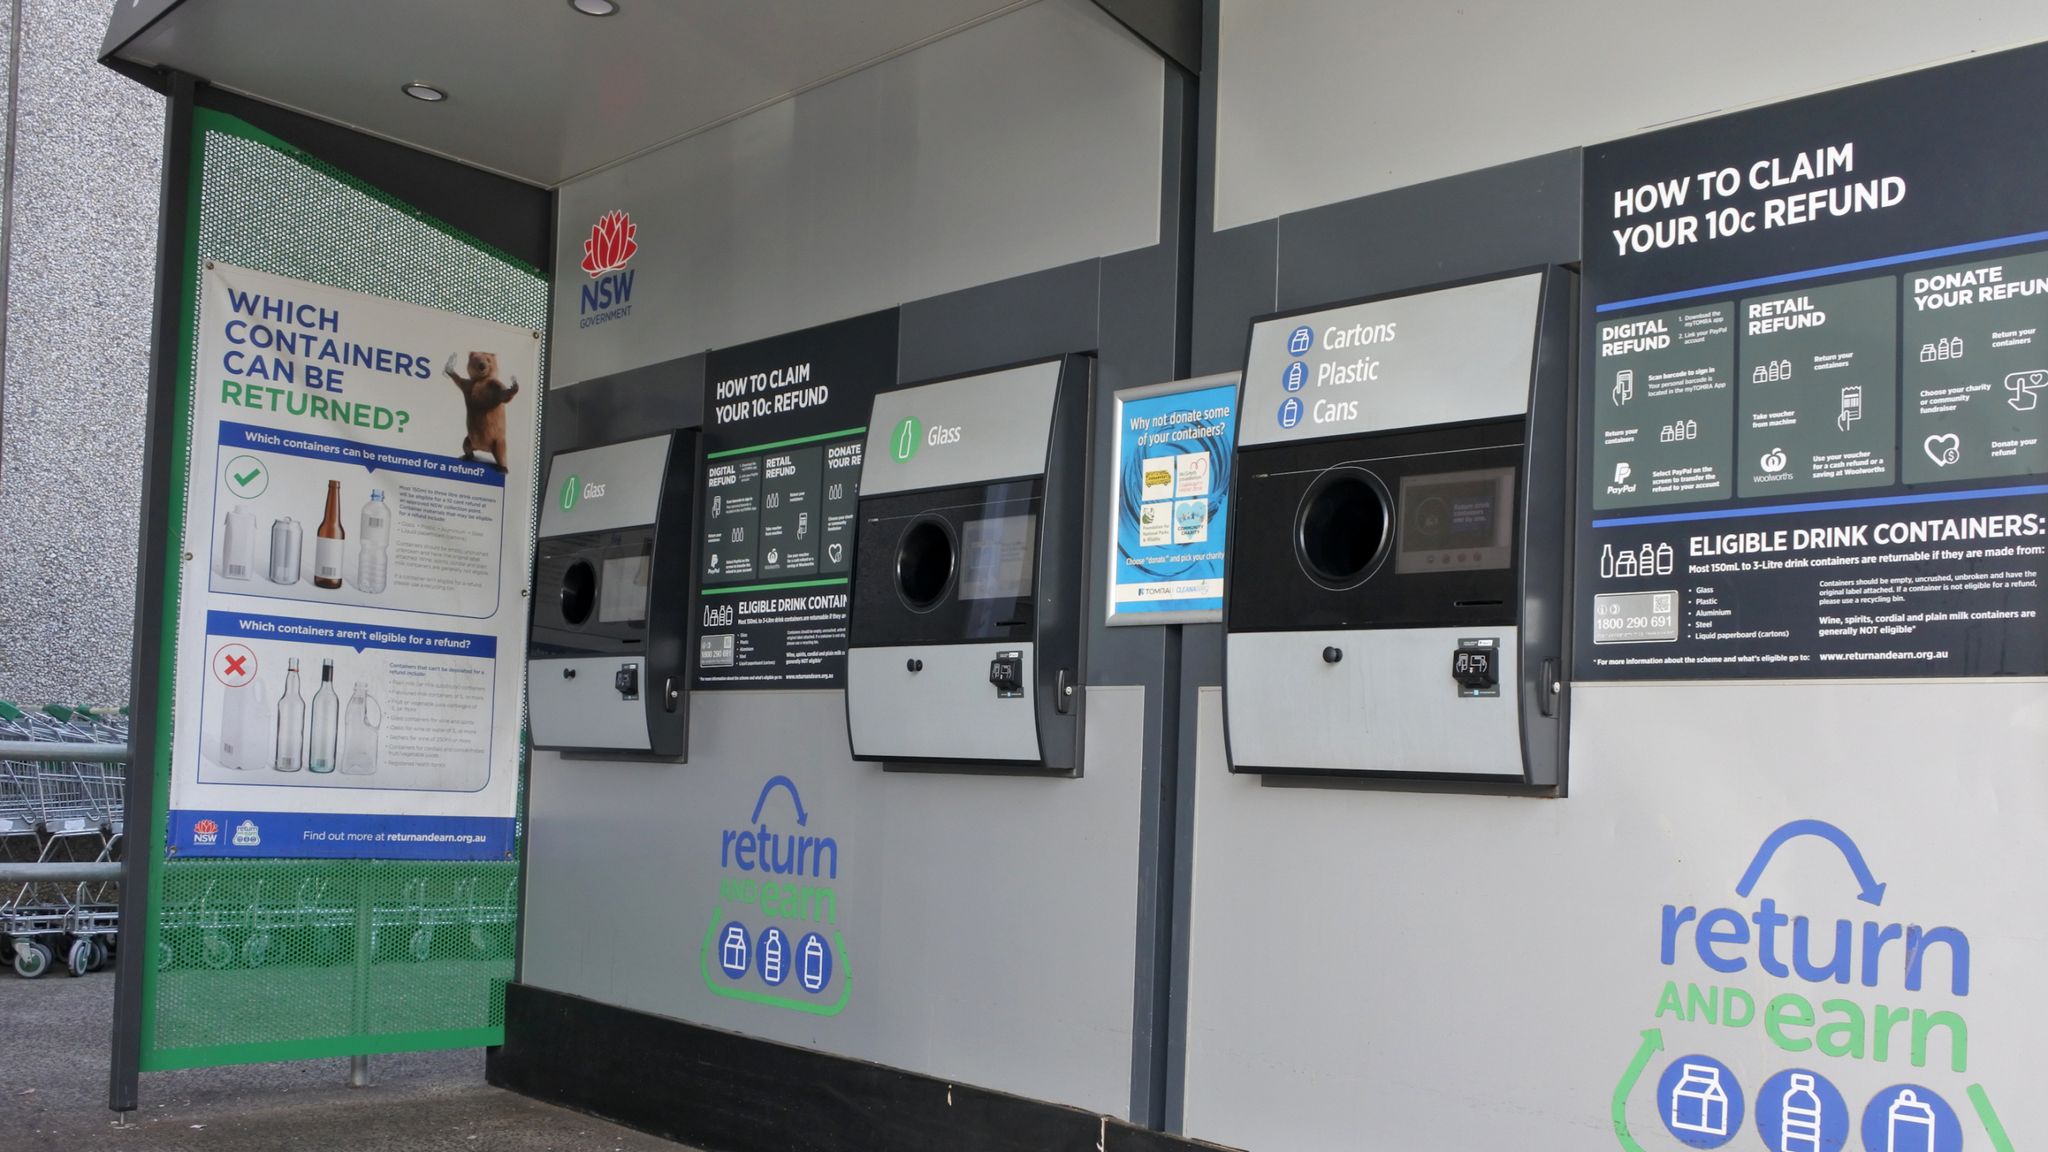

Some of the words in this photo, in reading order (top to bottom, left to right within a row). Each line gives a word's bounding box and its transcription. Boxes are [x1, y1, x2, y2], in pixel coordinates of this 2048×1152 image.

[1614, 176, 1690, 218] HOW
[1698, 167, 1740, 200] TO
[1749, 142, 1853, 190] CLAIM
[1613, 216, 1698, 256] YOUR
[1706, 207, 1755, 239] 10c
[1764, 176, 1906, 229] REFUND
[1915, 266, 2002, 293] DONATE
[581, 269, 635, 315] NSW
[1914, 290, 1973, 311] YOUR
[227, 288, 339, 333] WHICH
[580, 305, 632, 328] GOVERNMENT
[1749, 296, 1814, 318] RETAIL
[1602, 319, 1668, 341] DIGITAL
[1749, 312, 1826, 335] REFUND
[1992, 331, 2017, 339] Return
[2019, 328, 2036, 337] your
[1323, 322, 1396, 350] Cartons
[1602, 335, 1670, 357] REFUND
[1992, 337, 2031, 348] containers
[225, 319, 431, 379] CONTAINERS
[223, 350, 294, 384] CAN
[305, 366, 344, 393] BE
[717, 376, 748, 400] HOW
[750, 373, 767, 393] TO
[770, 363, 810, 389] CLAIM
[1317, 357, 1379, 387] Plastic
[1920, 389, 1947, 398] Choose
[1948, 387, 1964, 396] your
[1966, 383, 1991, 394] charity
[1930, 394, 1970, 405] community
[221, 380, 411, 432] RETURNED?
[716, 401, 749, 424] YOUR
[752, 398, 772, 417] 10c
[774, 385, 828, 413] REFUND
[1313, 399, 1358, 423] Cans
[1769, 410, 1795, 419] voucher
[1920, 404, 1957, 414] fundraiser
[1130, 417, 1150, 431] Why
[1152, 414, 1168, 426] not
[1170, 410, 1202, 424] donate
[1204, 406, 1230, 419] some
[1753, 420, 1768, 428] from
[1769, 418, 1796, 427] machine
[928, 425, 961, 446] Glass
[1138, 433, 1147, 446] of
[1149, 431, 1169, 447] your
[1172, 422, 1225, 441] containers?
[1992, 440, 2018, 449] Donate
[2020, 437, 2037, 447] your
[245, 431, 281, 447] Which
[283, 438, 340, 454] containers
[343, 447, 361, 457] can
[363, 449, 375, 460] be
[378, 452, 421, 467] returned
[423, 459, 438, 470] for
[440, 463, 446, 471] a
[448, 463, 485, 477] refund?
[828, 444, 861, 458] DONATE
[1992, 448, 2016, 457] refund
[709, 465, 736, 477] DIGITAL
[766, 456, 791, 468] RETAIL
[766, 466, 796, 479] REFUND
[828, 459, 849, 469] YOUR
[584, 483, 606, 499] Glass
[709, 475, 736, 487] REFUND
[1607, 484, 1636, 494] PayPal
[1690, 530, 1787, 557] ELIGIBLE
[1793, 524, 1868, 550] DRINK
[1873, 513, 2046, 545] CONTAINERS:
[1689, 564, 1710, 574] Most
[1712, 563, 1740, 573] 150mL
[1742, 563, 1751, 571] to
[1753, 560, 1783, 570] 3-Litre
[1785, 558, 1809, 569] drink
[1810, 555, 1859, 567] containers
[1861, 554, 1877, 564] are
[1879, 551, 1930, 563] returnable
[1932, 550, 1940, 560] if
[1942, 549, 1963, 559] they
[1966, 549, 1983, 558] are
[1985, 547, 2014, 557] made
[2017, 545, 2045, 555] from:
[738, 600, 777, 614] ELIGIBLE
[778, 597, 807, 612] DRINK
[1696, 598, 1718, 606] Plastic
[1598, 617, 1623, 630] 1800
[1627, 617, 1647, 629] 290
[1651, 616, 1672, 627] 691
[1696, 609, 1731, 617] Aluminium
[1819, 616, 1843, 626] Wine,
[1845, 615, 1873, 624] spirits,
[1875, 614, 1905, 623] cordial
[1907, 613, 1924, 622] and
[1926, 612, 1947, 622] plain
[1949, 612, 1969, 620] milk
[1971, 610, 2019, 619] containers
[2021, 610, 2036, 618] are
[239, 619, 275, 632] Which
[278, 625, 334, 637] containers
[336, 628, 367, 640] aren't
[369, 631, 407, 644] eligible
[409, 634, 424, 645] for
[426, 638, 432, 646] a
[434, 637, 471, 649] refund?
[1695, 632, 1716, 641] Liquid
[1718, 630, 1756, 640] paperboard
[1758, 630, 1789, 639] (cartons)
[1696, 621, 1712, 629] Steel
[1819, 627, 1857, 638] generally
[1859, 626, 1878, 634] NOT
[1626, 657, 1663, 665] information
[1664, 656, 1683, 664] about
[1685, 656, 1695, 664] the
[1762, 654, 1787, 663] eligible
[1789, 655, 1799, 663] go
[1800, 654, 1810, 662] to:
[1820, 651, 1948, 661] www.returnandearn.org.au
[194, 834, 218, 842] NSW
[303, 830, 325, 841] Find
[328, 831, 345, 841] out
[347, 833, 373, 841] more
[375, 833, 385, 841] at
[387, 832, 486, 843] returnandearn.org.au
[721, 824, 837, 879] return
[719, 877, 758, 905] AND
[760, 879, 836, 925] earn
[1660, 898, 1970, 997] return
[1655, 981, 1755, 1028] AND
[1764, 993, 1968, 1073] earn
